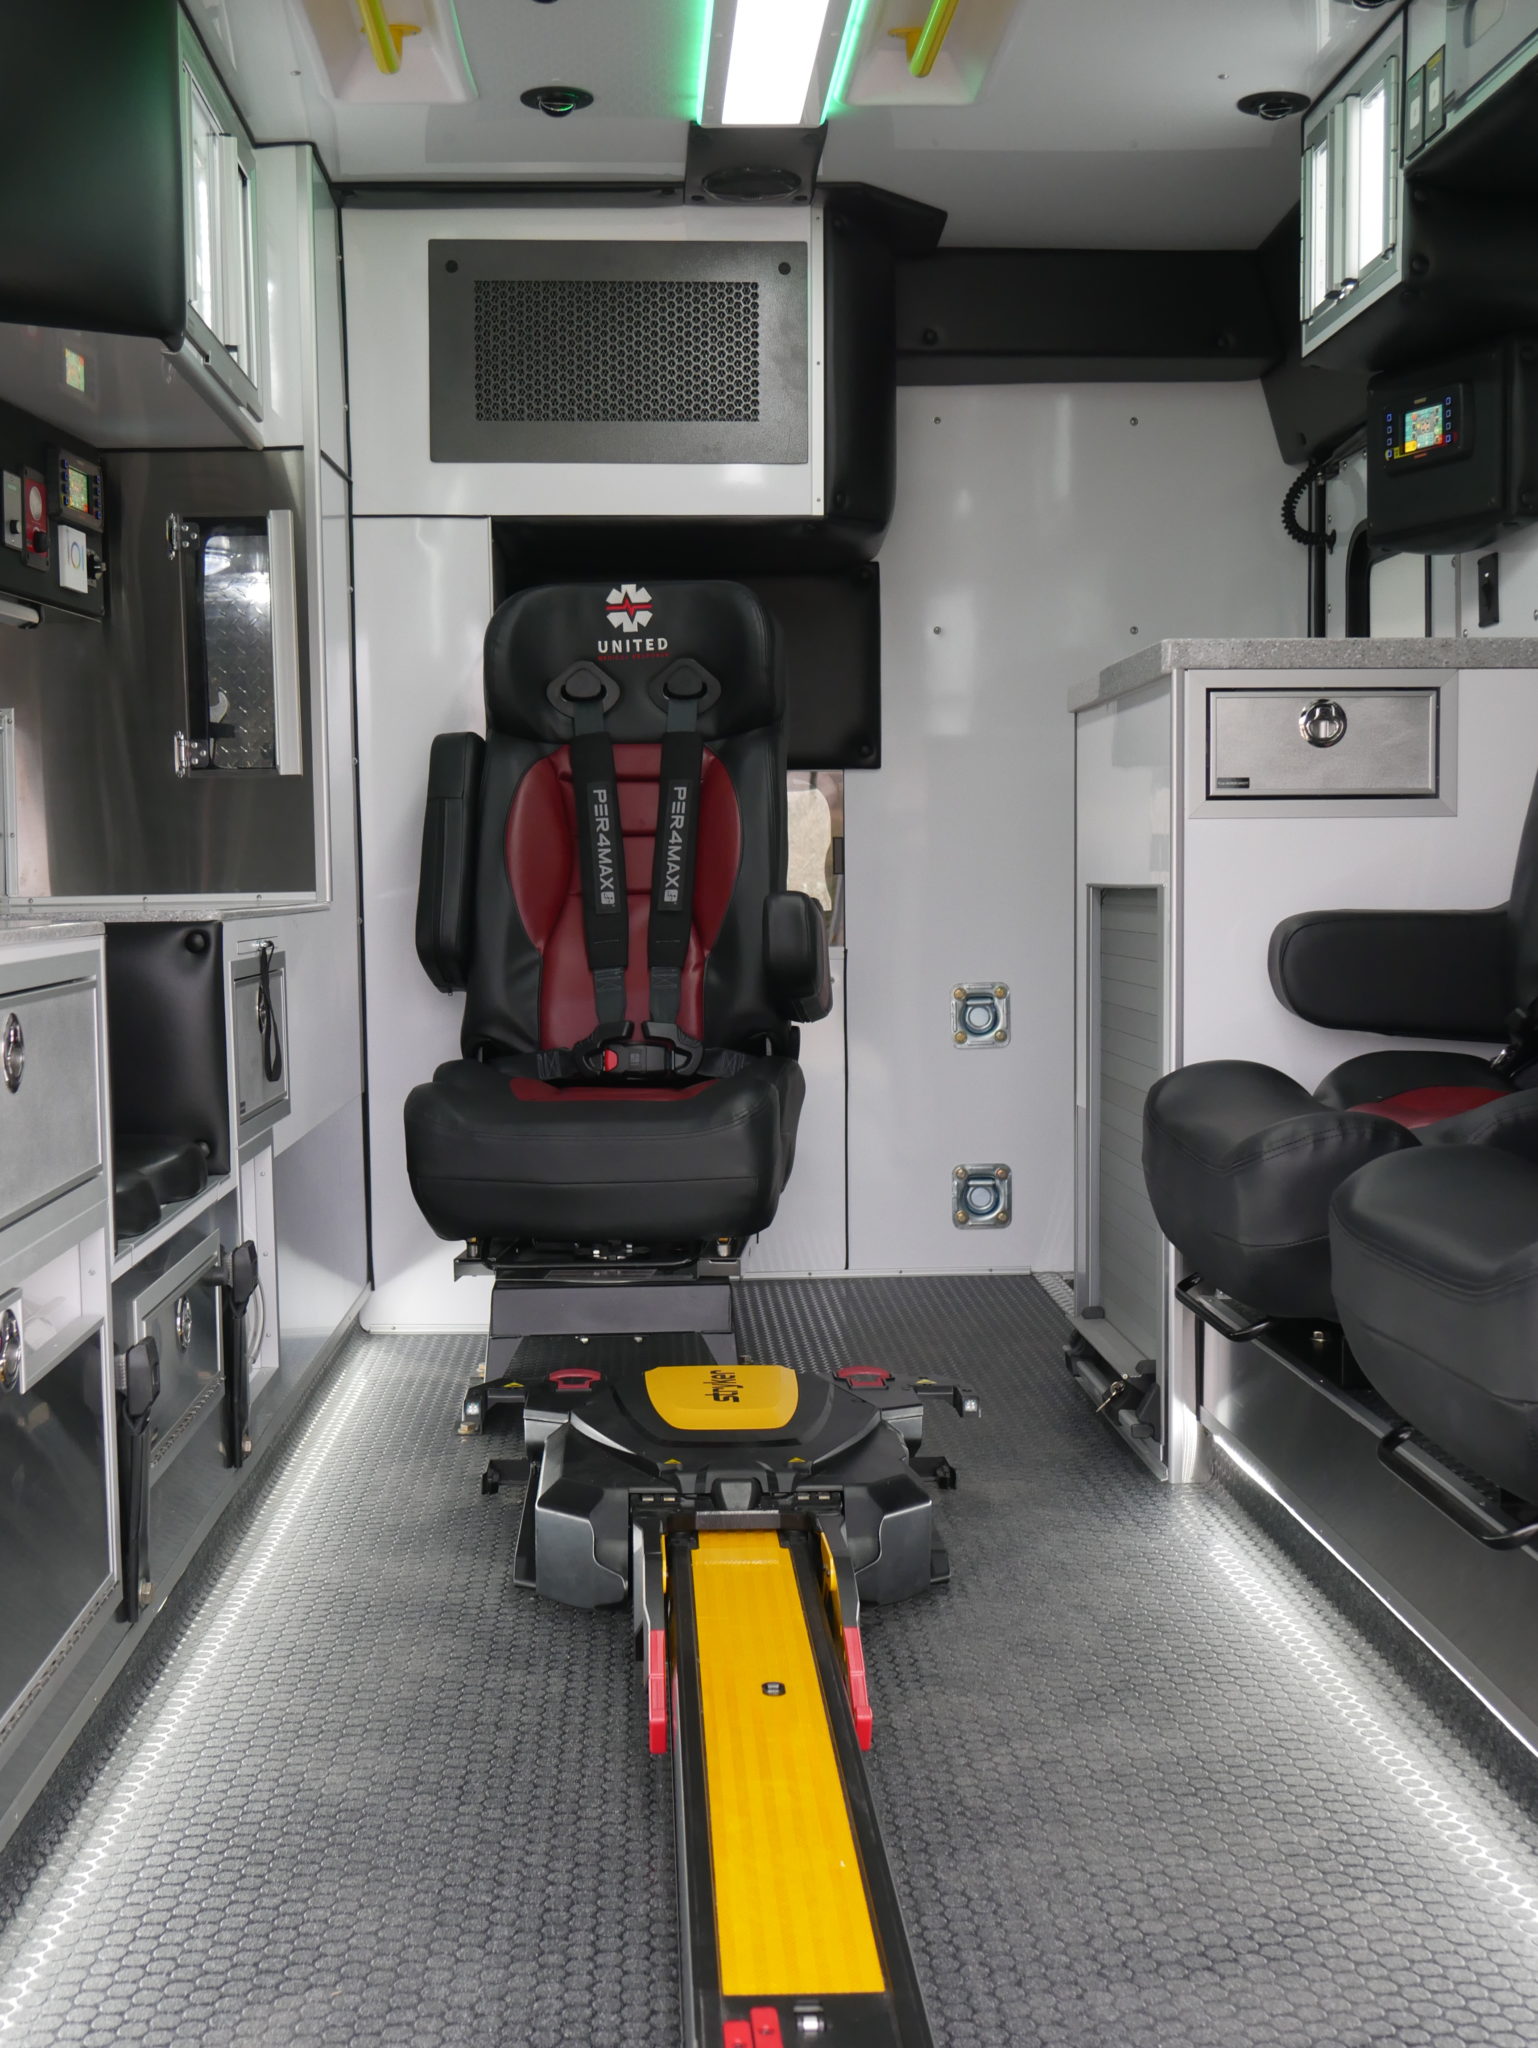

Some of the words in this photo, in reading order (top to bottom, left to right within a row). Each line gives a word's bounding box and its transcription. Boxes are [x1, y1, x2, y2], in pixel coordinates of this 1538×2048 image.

[597, 637, 668, 653] UNITED
[593, 789, 614, 890] PER4MAX
[665, 786, 687, 888] PER4MAX
[703, 1369, 744, 1403] stryker
